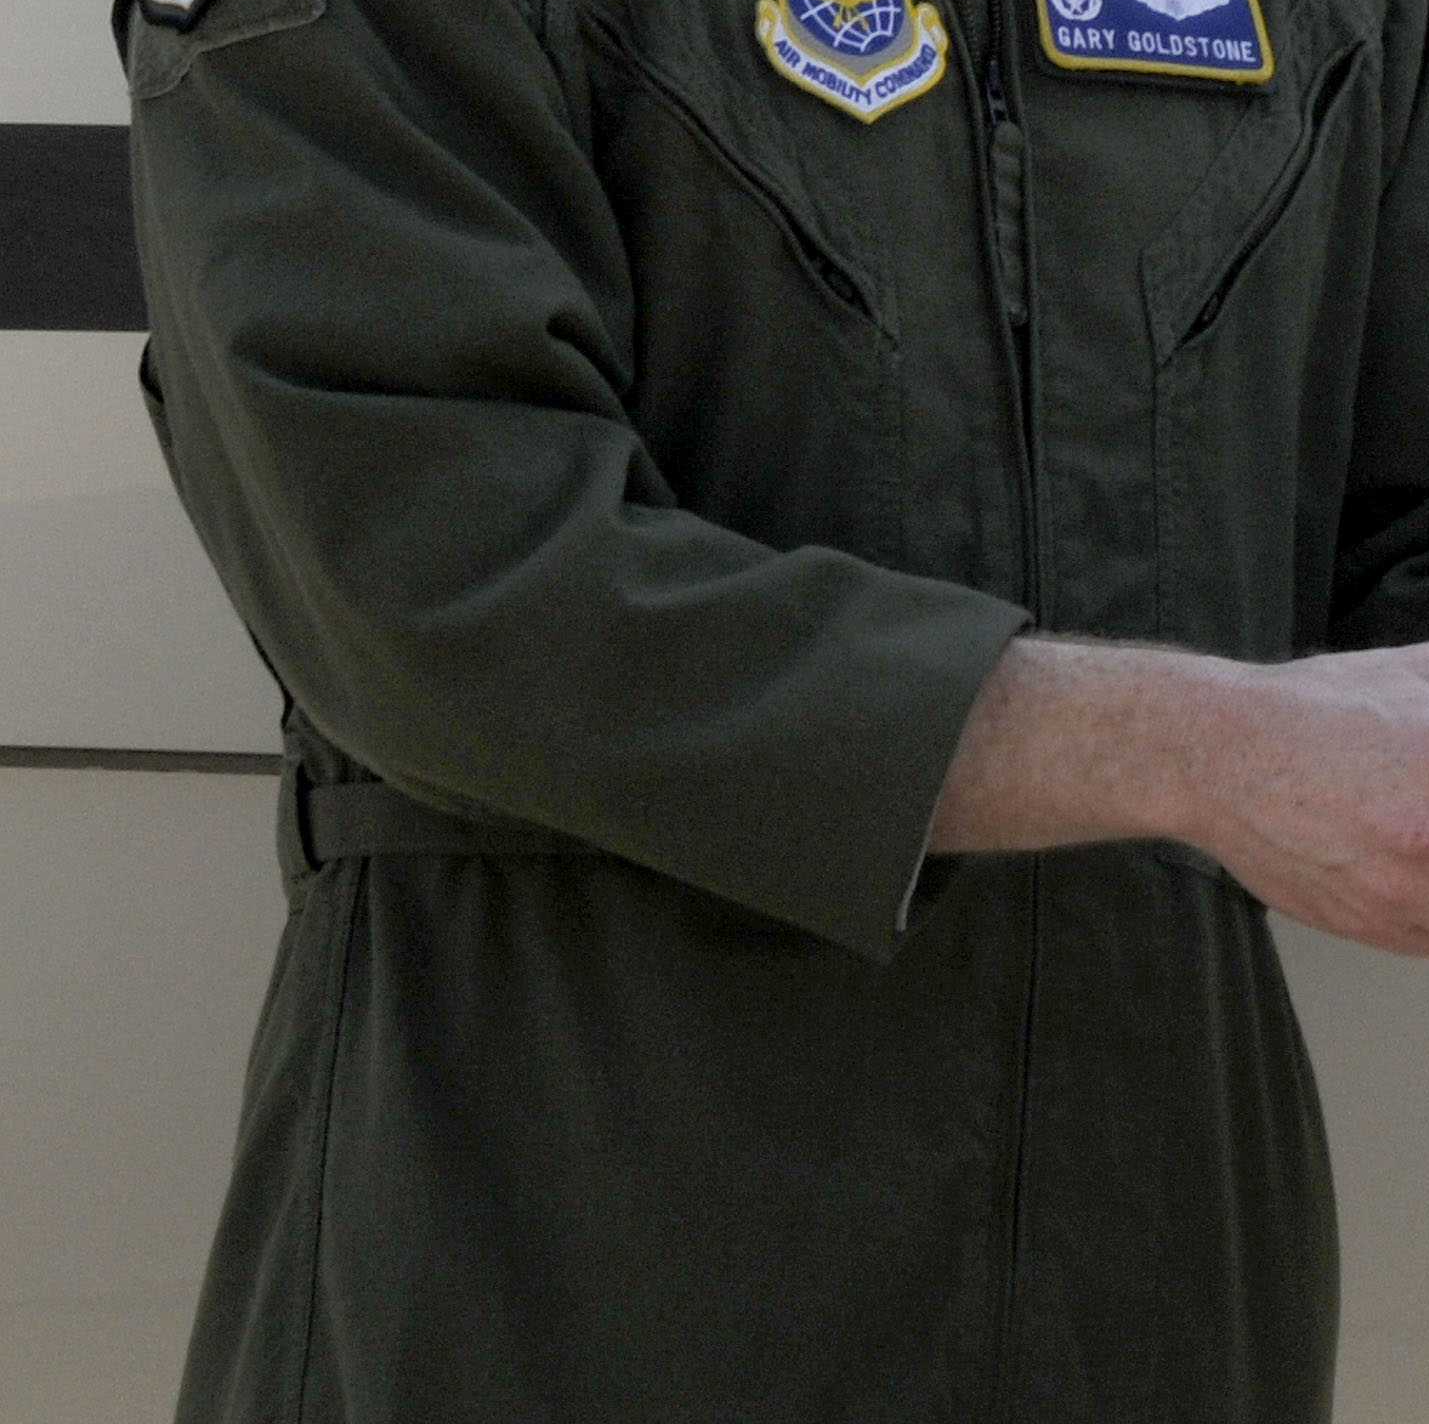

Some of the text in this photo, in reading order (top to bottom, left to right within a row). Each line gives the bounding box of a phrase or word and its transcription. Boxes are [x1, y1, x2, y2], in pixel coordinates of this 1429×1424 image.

[1057, 26, 1257, 63] GARY GOLDSTONE
[774, 40, 937, 105] AIR MOBILITY COMMAND
